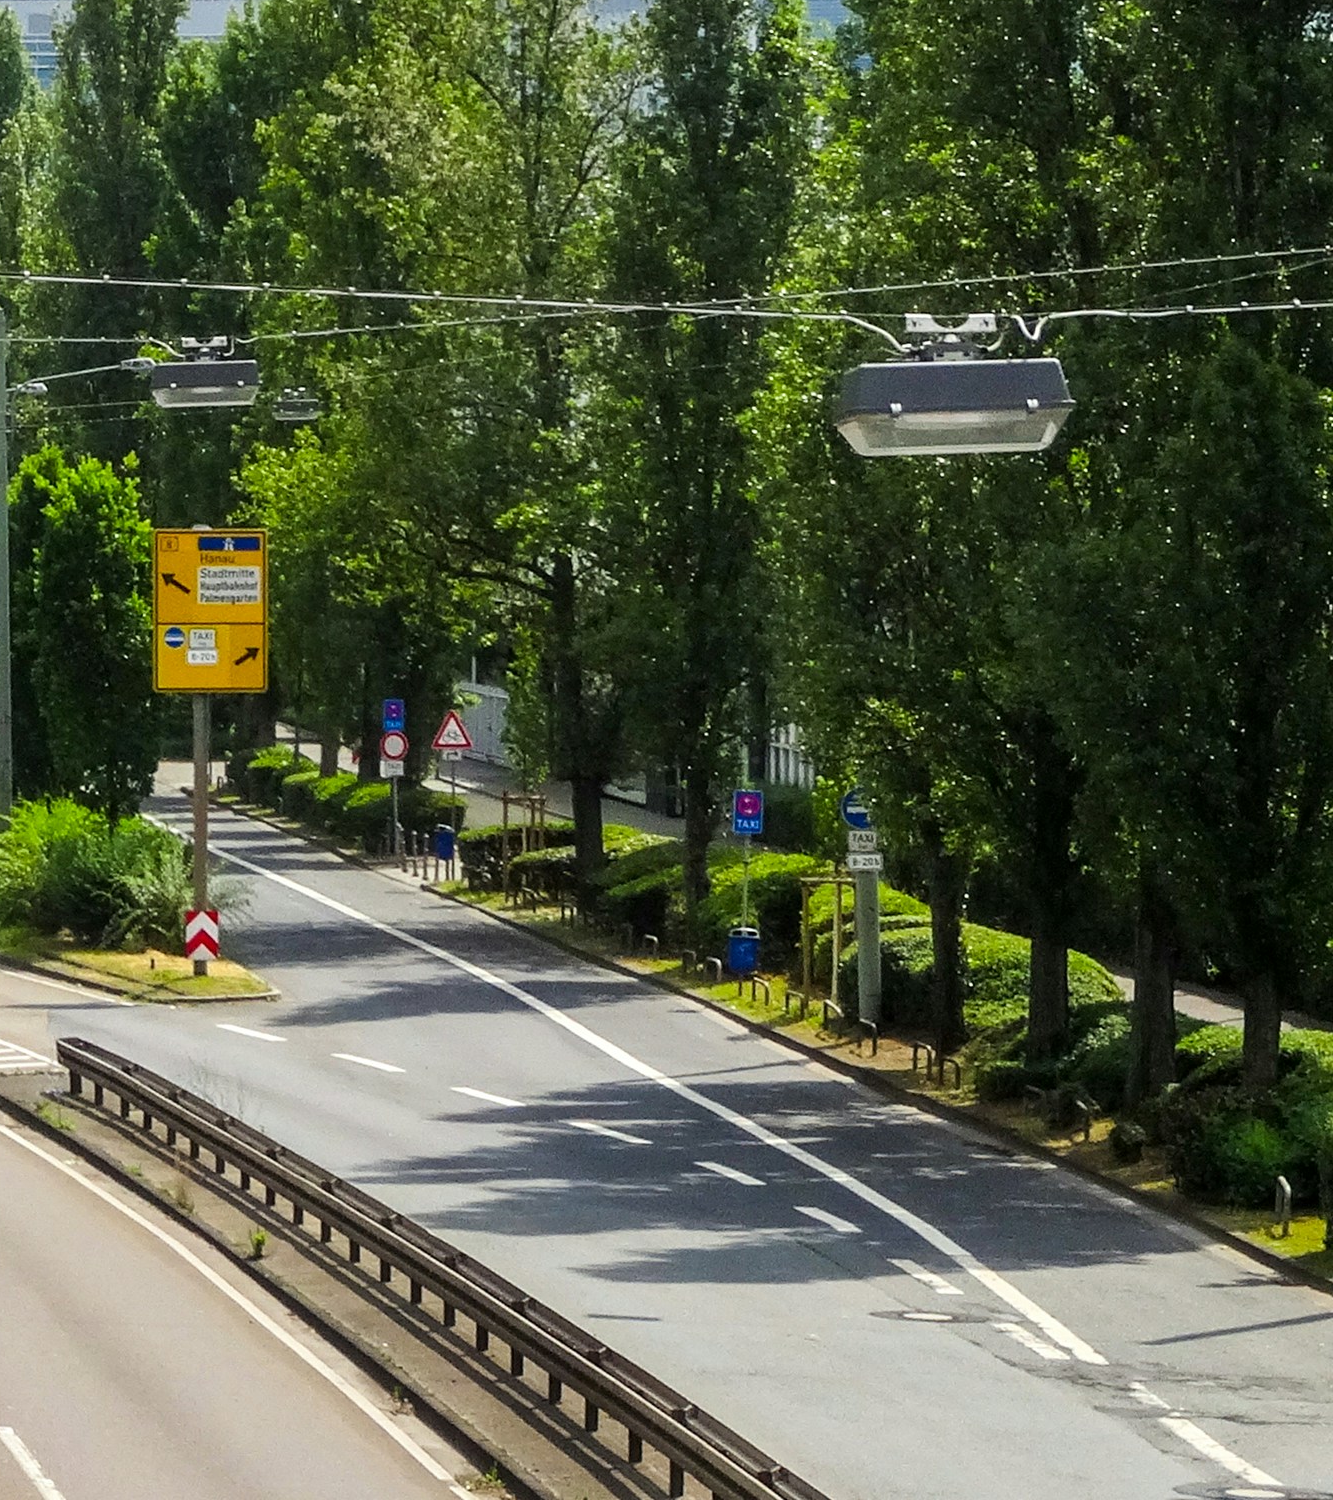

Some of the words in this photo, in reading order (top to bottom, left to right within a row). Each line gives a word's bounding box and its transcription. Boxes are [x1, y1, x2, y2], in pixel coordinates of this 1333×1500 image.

[200, 554, 236, 564] Hanau
[200, 568, 255, 579] Stadtmitte
[193, 631, 214, 640] TAXI
[737, 820, 760, 829] TAXI
[852, 833, 875, 843] TAXI
